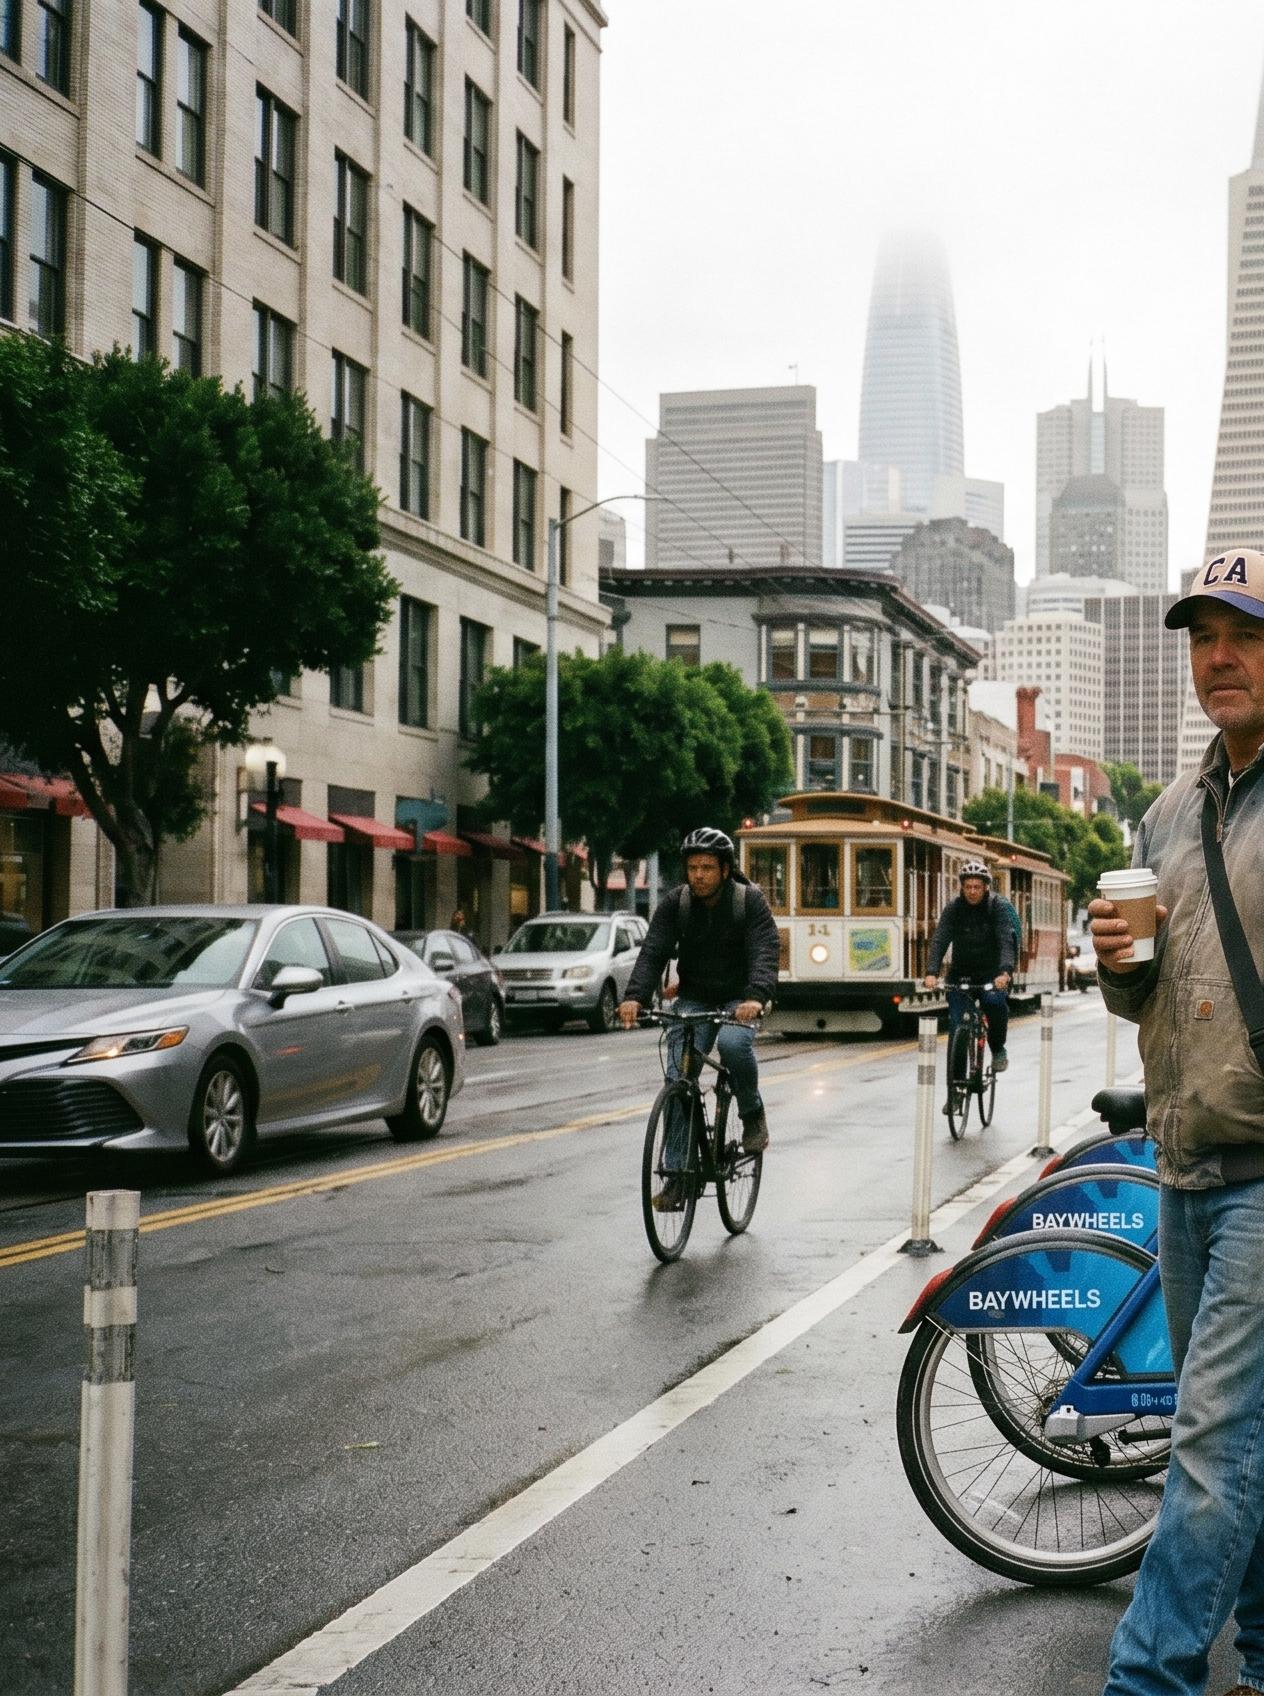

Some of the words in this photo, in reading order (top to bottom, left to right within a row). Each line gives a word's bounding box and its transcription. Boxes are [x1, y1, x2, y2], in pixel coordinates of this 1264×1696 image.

[1203, 556, 1248, 586] CA
[1032, 1213, 1144, 1229] BAYWHEELS
[969, 1289, 1101, 1311] BAYWHEELS
